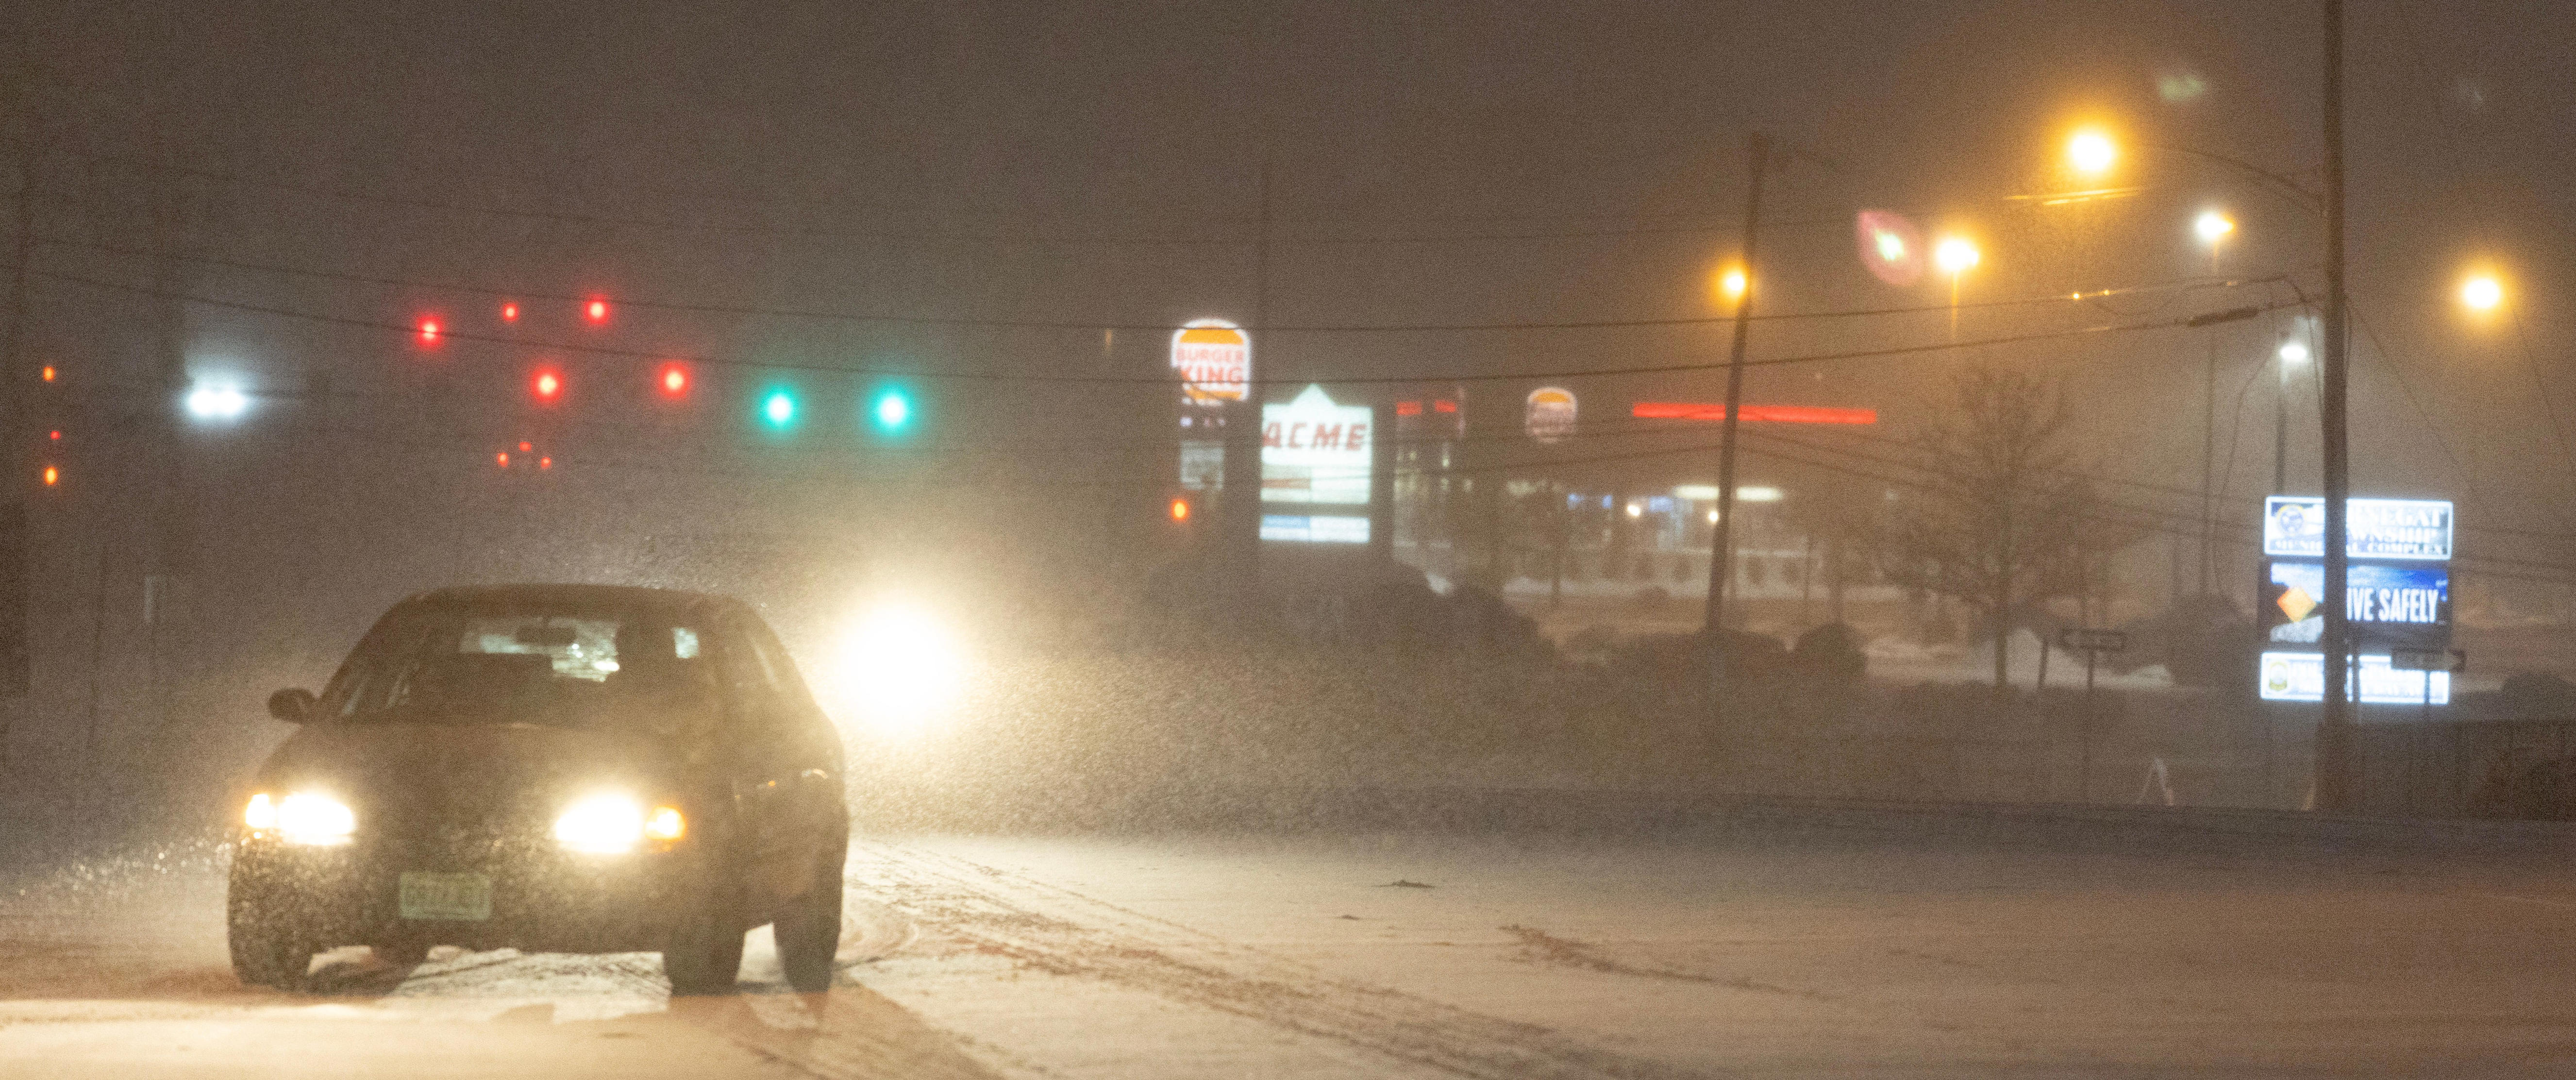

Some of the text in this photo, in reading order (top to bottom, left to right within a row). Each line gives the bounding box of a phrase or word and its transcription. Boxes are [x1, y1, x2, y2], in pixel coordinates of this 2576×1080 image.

[1175, 348, 1245, 363] BURGER
[1179, 366, 1244, 385] KING
[1262, 422, 1367, 451] ACME
[2347, 527, 2438, 543] WNSHIP
[2346, 587, 2439, 624] IVE SAFELY
